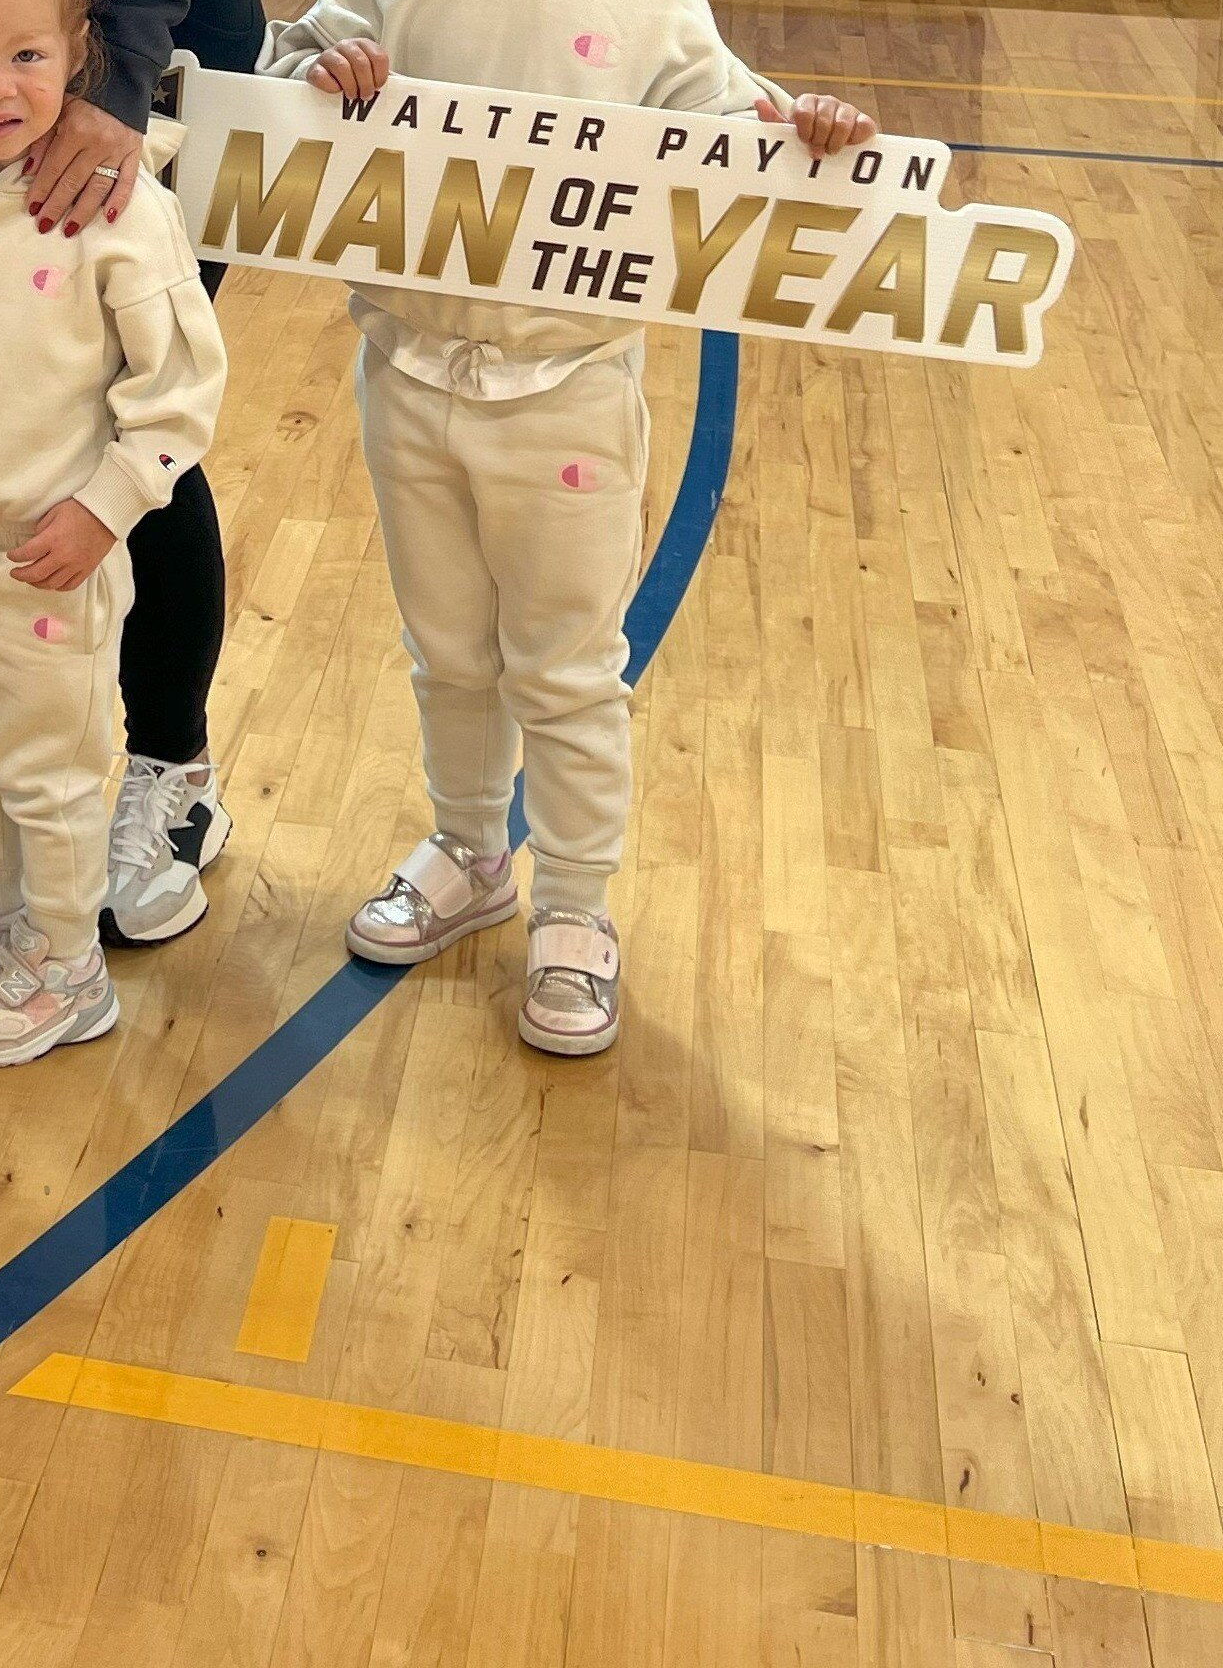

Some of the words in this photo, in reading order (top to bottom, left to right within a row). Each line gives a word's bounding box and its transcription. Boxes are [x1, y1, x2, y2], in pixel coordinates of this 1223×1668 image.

[342, 90, 605, 151] WALTER
[199, 129, 534, 287] MAN
[550, 177, 639, 231] OF
[666, 186, 1059, 355] YEAR
[531, 240, 654, 304] THE
